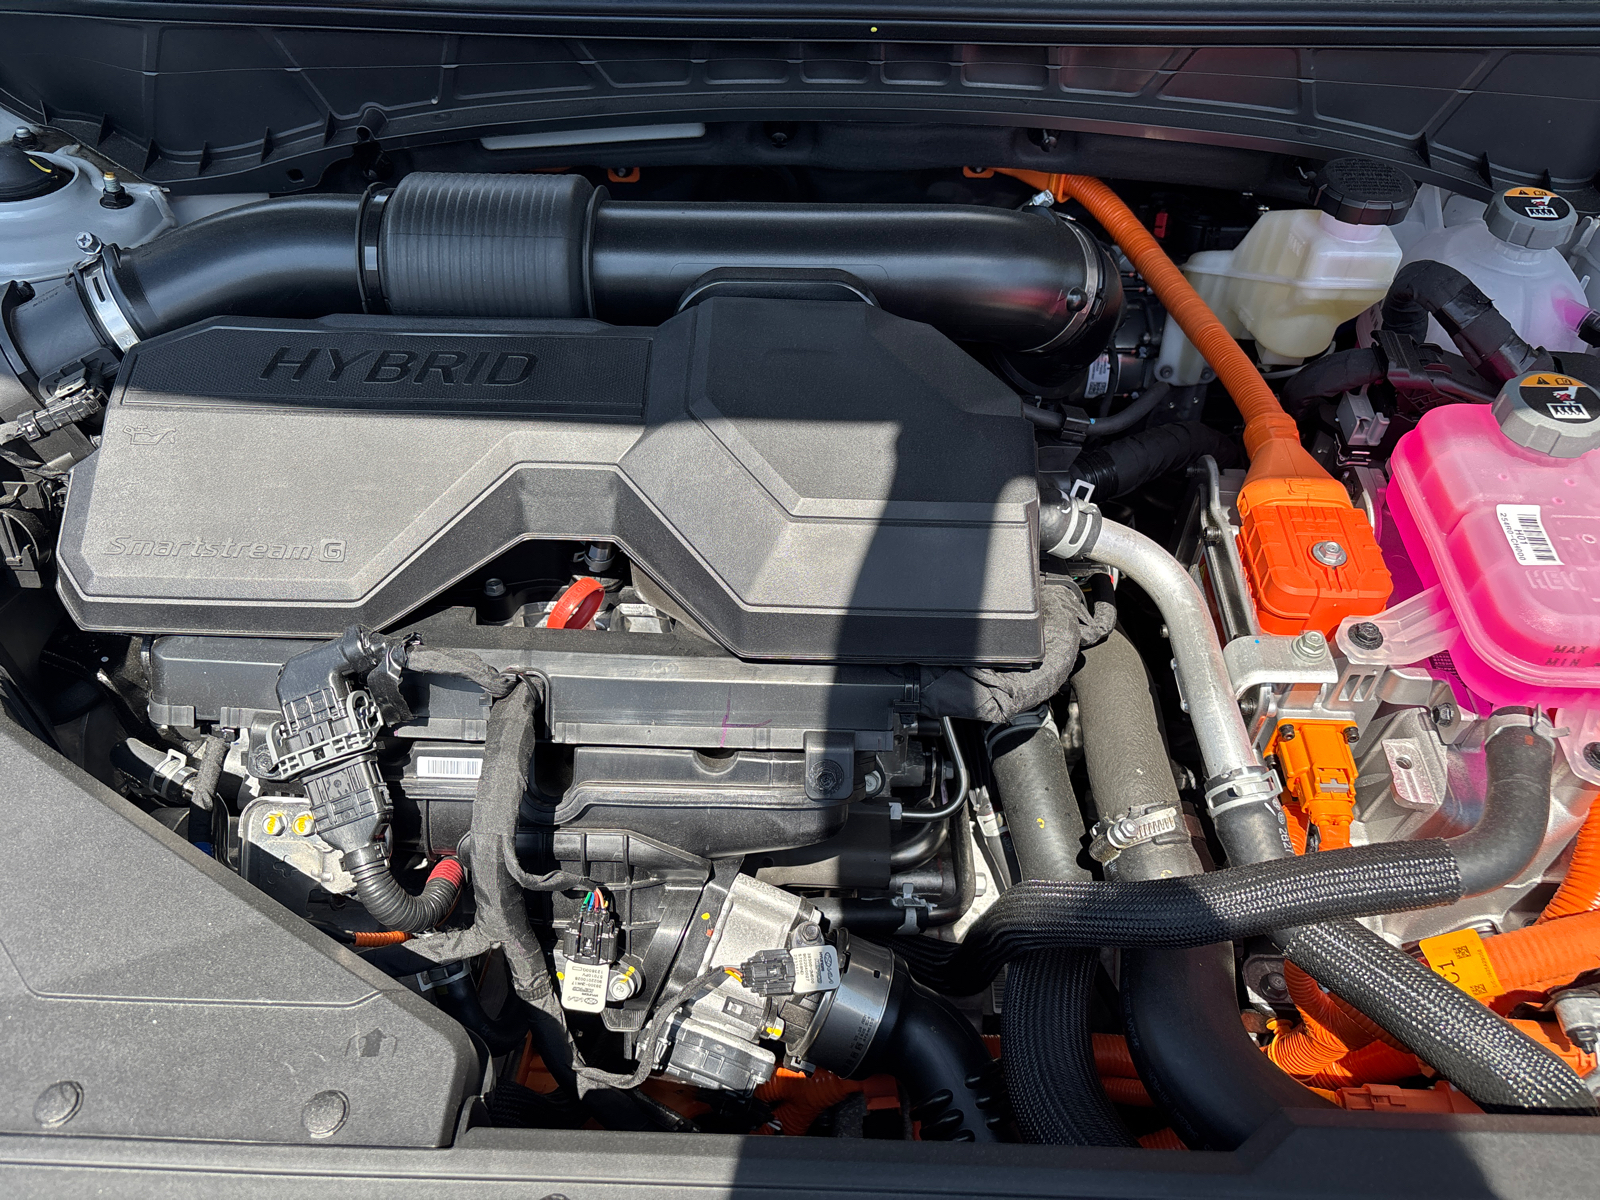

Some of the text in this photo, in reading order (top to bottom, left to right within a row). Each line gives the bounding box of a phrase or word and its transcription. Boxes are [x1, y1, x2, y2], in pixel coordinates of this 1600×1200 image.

[258, 345, 538, 387] HYBRID
[1514, 529, 1528, 545] H01
[103, 534, 346, 562] Smartstream G
[1553, 644, 1590, 655] MAX
[1545, 657, 1581, 668] MIN
